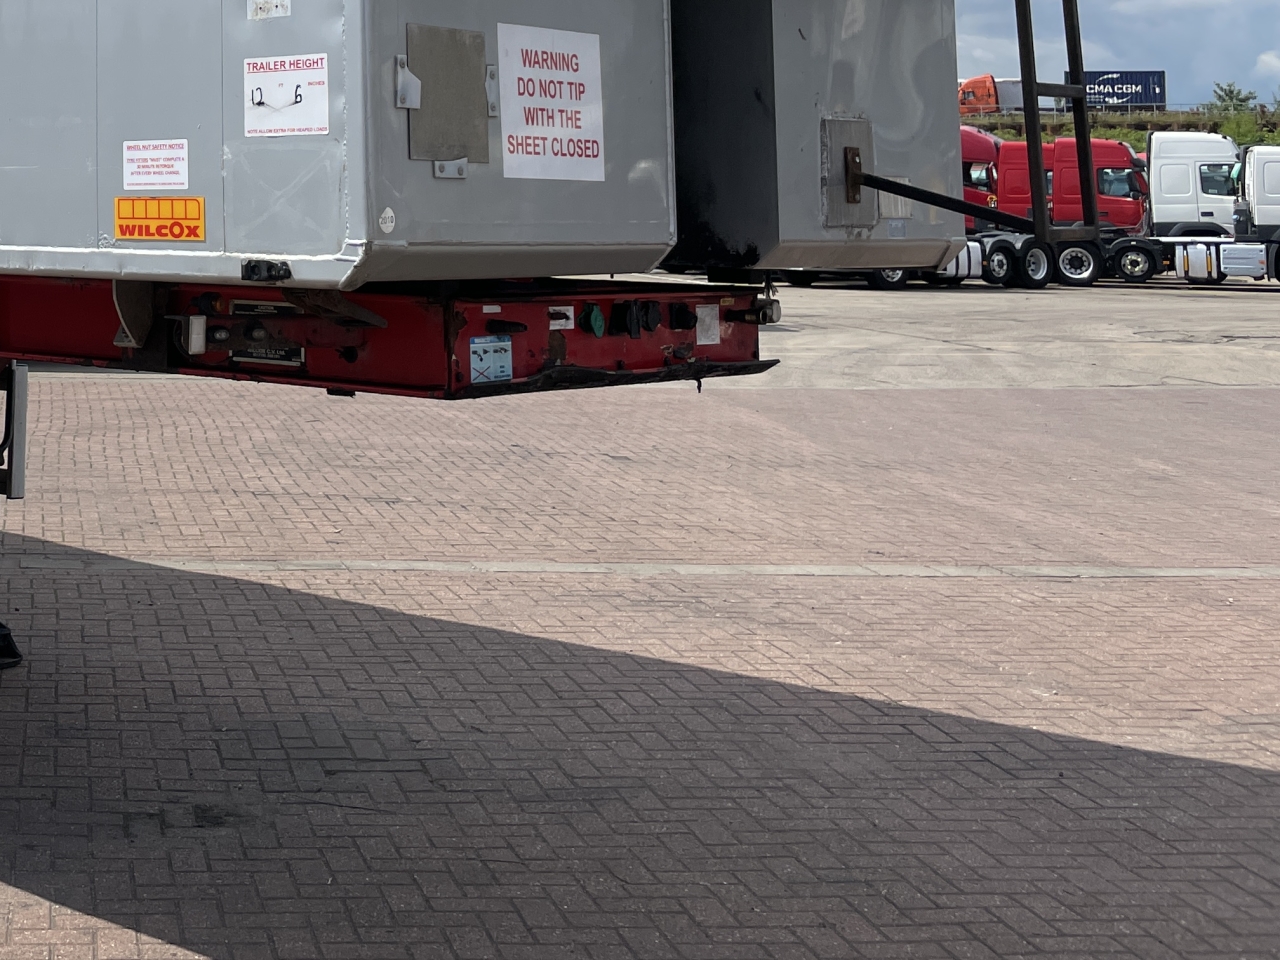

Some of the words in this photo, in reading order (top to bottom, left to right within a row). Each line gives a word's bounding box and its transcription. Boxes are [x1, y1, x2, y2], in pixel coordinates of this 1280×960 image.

[246, 60, 286, 72] TRAILER
[288, 57, 325, 69] HEIGHT
[521, 48, 580, 73] WARNING
[294, 84, 303, 104] 6
[517, 77, 536, 97] DO
[539, 79, 564, 100] NOT
[567, 82, 586, 101] TIP
[1086, 84, 1113, 94] CMA
[1114, 84, 1142, 94] CGM
[523, 106, 555, 127] WITH
[558, 108, 582, 129] THE
[507, 134, 548, 156] SHEET
[551, 137, 600, 159] CLOSED
[118, 221, 200, 239] WILCOX
